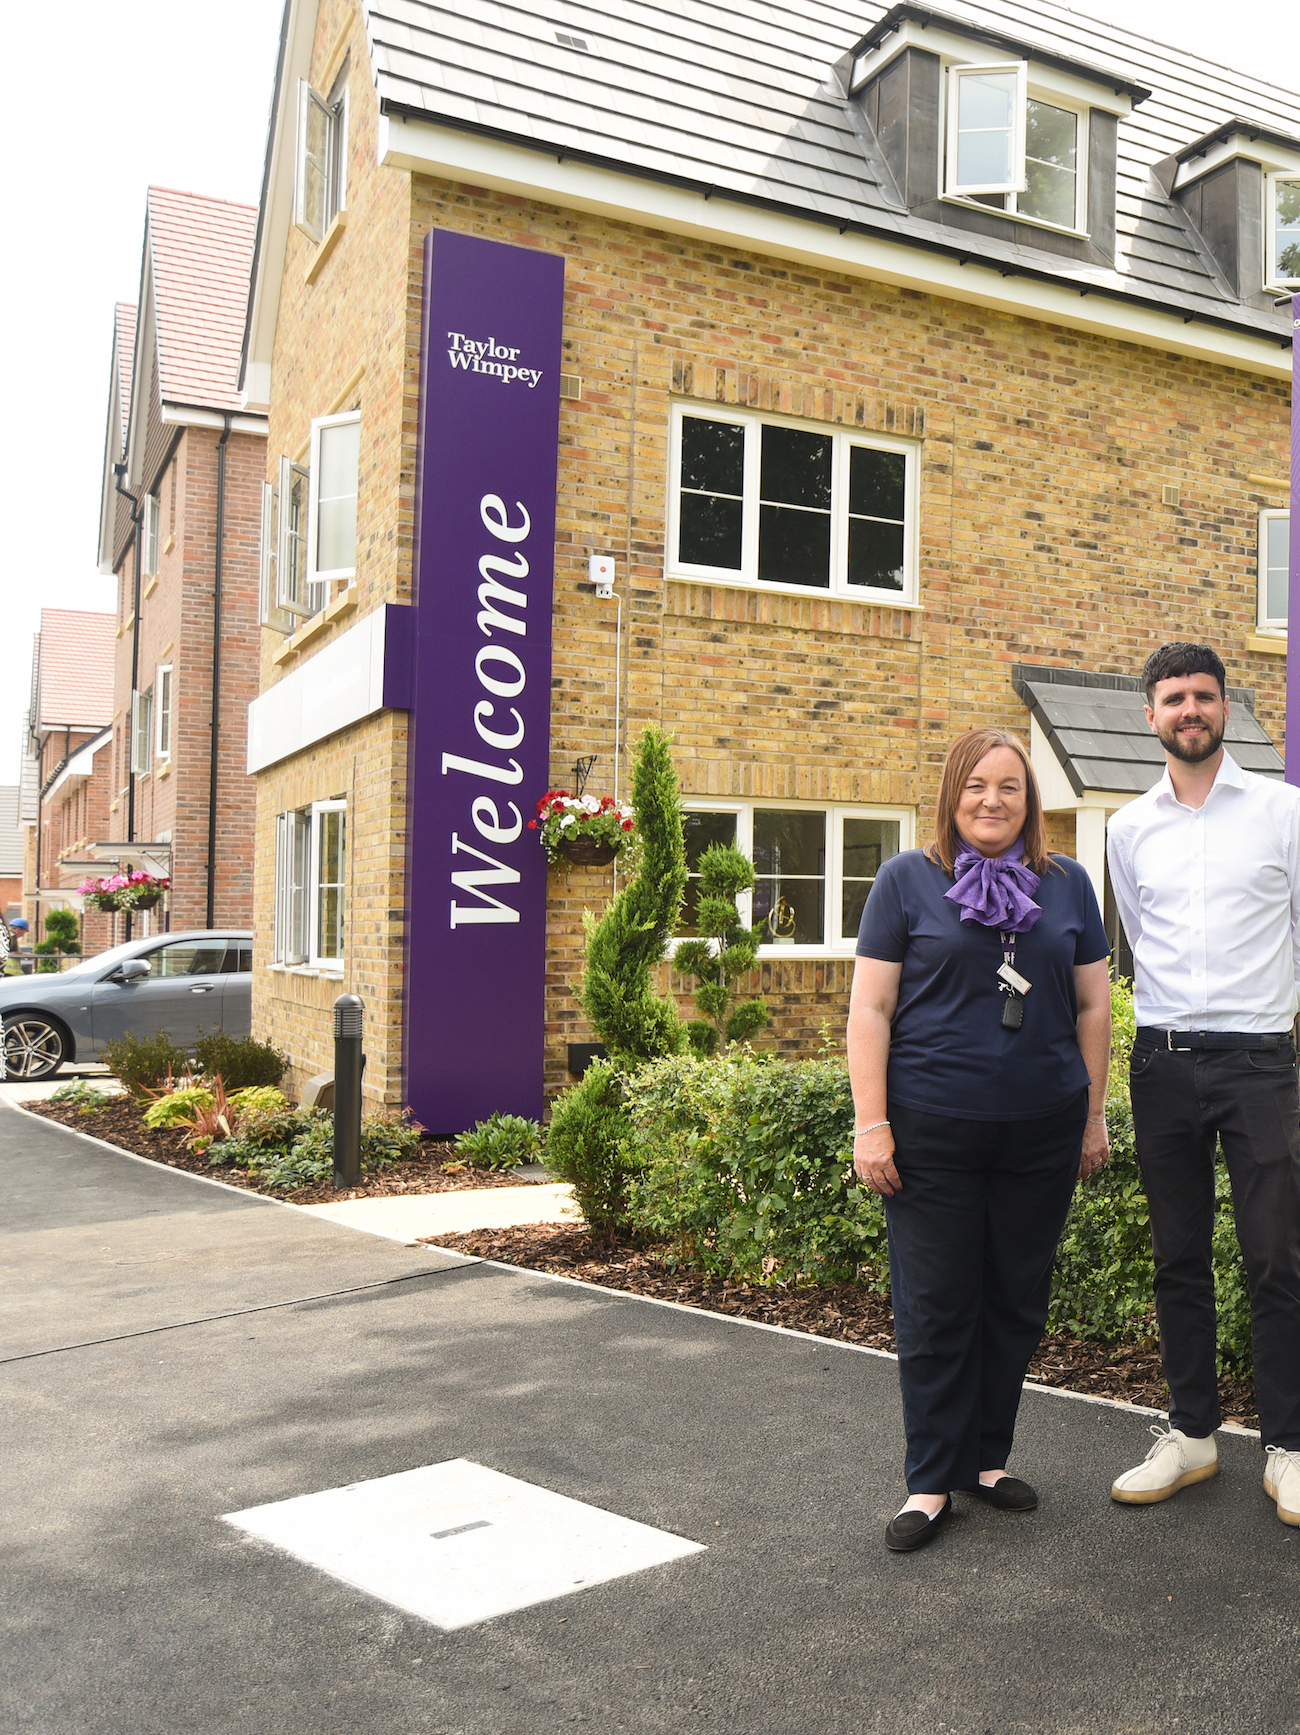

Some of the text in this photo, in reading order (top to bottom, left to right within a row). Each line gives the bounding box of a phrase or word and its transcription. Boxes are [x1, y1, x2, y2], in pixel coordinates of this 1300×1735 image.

[447, 331, 521, 362] Taylor
[447, 349, 543, 389] Wimpey
[441, 493, 531, 930] Welcome
